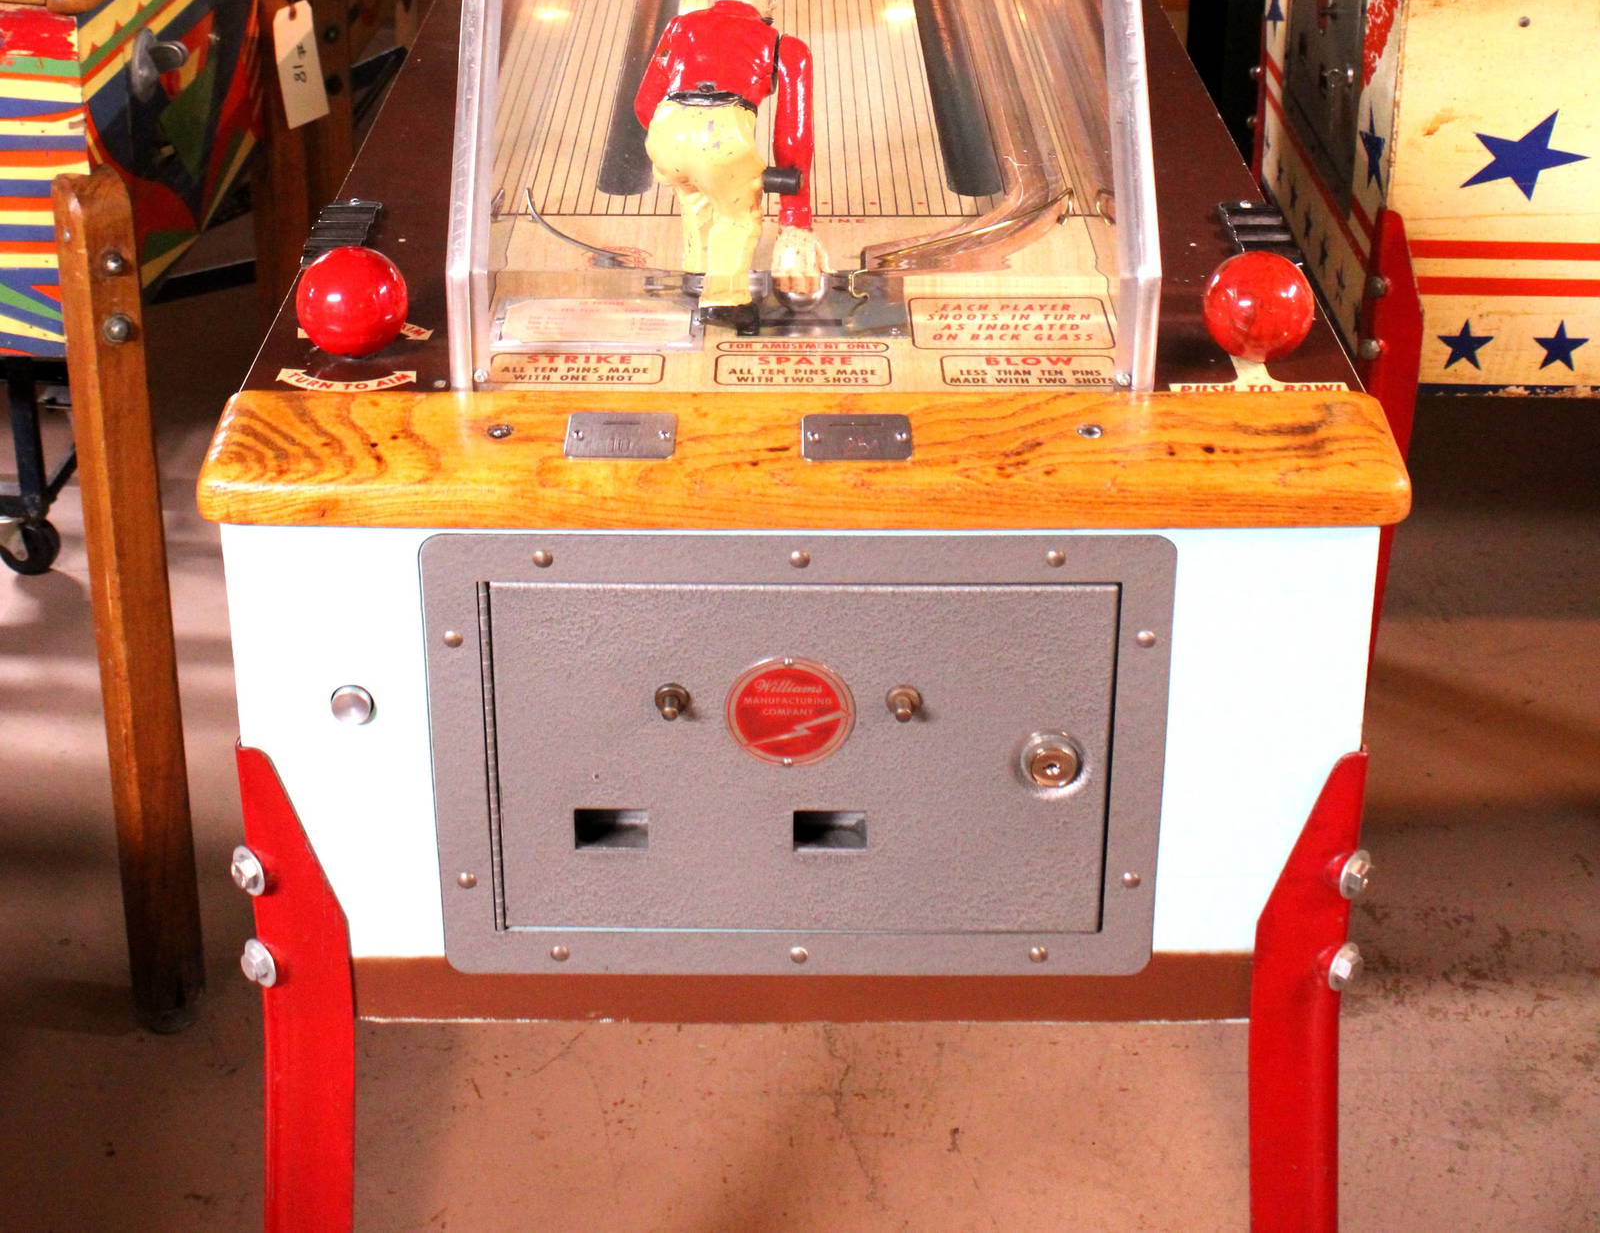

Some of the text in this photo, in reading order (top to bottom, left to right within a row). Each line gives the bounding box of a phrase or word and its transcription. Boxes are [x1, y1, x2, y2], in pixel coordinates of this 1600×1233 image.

[940, 303, 1071, 312] EACH PLAYER
[927, 313, 1092, 321] SHOOTS IN TURN
[942, 323, 1080, 331] AS INDICATED
[932, 333, 1094, 342] ON BACK GLASS
[527, 354, 633, 365] STRIKE
[757, 356, 854, 366] SPARE
[985, 357, 1073, 366] BLOW
[501, 366, 526, 374] ALL
[534, 366, 559, 374] TEN
[608, 367, 649, 375] MADE
[761, 368, 787, 376] TEN
[794, 368, 828, 376] PINS
[287, 371, 412, 391] TURN TO AIM
[560, 374, 588, 382] ONE
[597, 374, 635, 382] SHOT
[823, 376, 870, 384] SHOTS
[950, 376, 1114, 384] MADE WITH TWO SHOTS
[754, 678, 823, 694] Williams
[744, 696, 833, 706] MANUFACTURING
[762, 708, 814, 717] COMPANY
